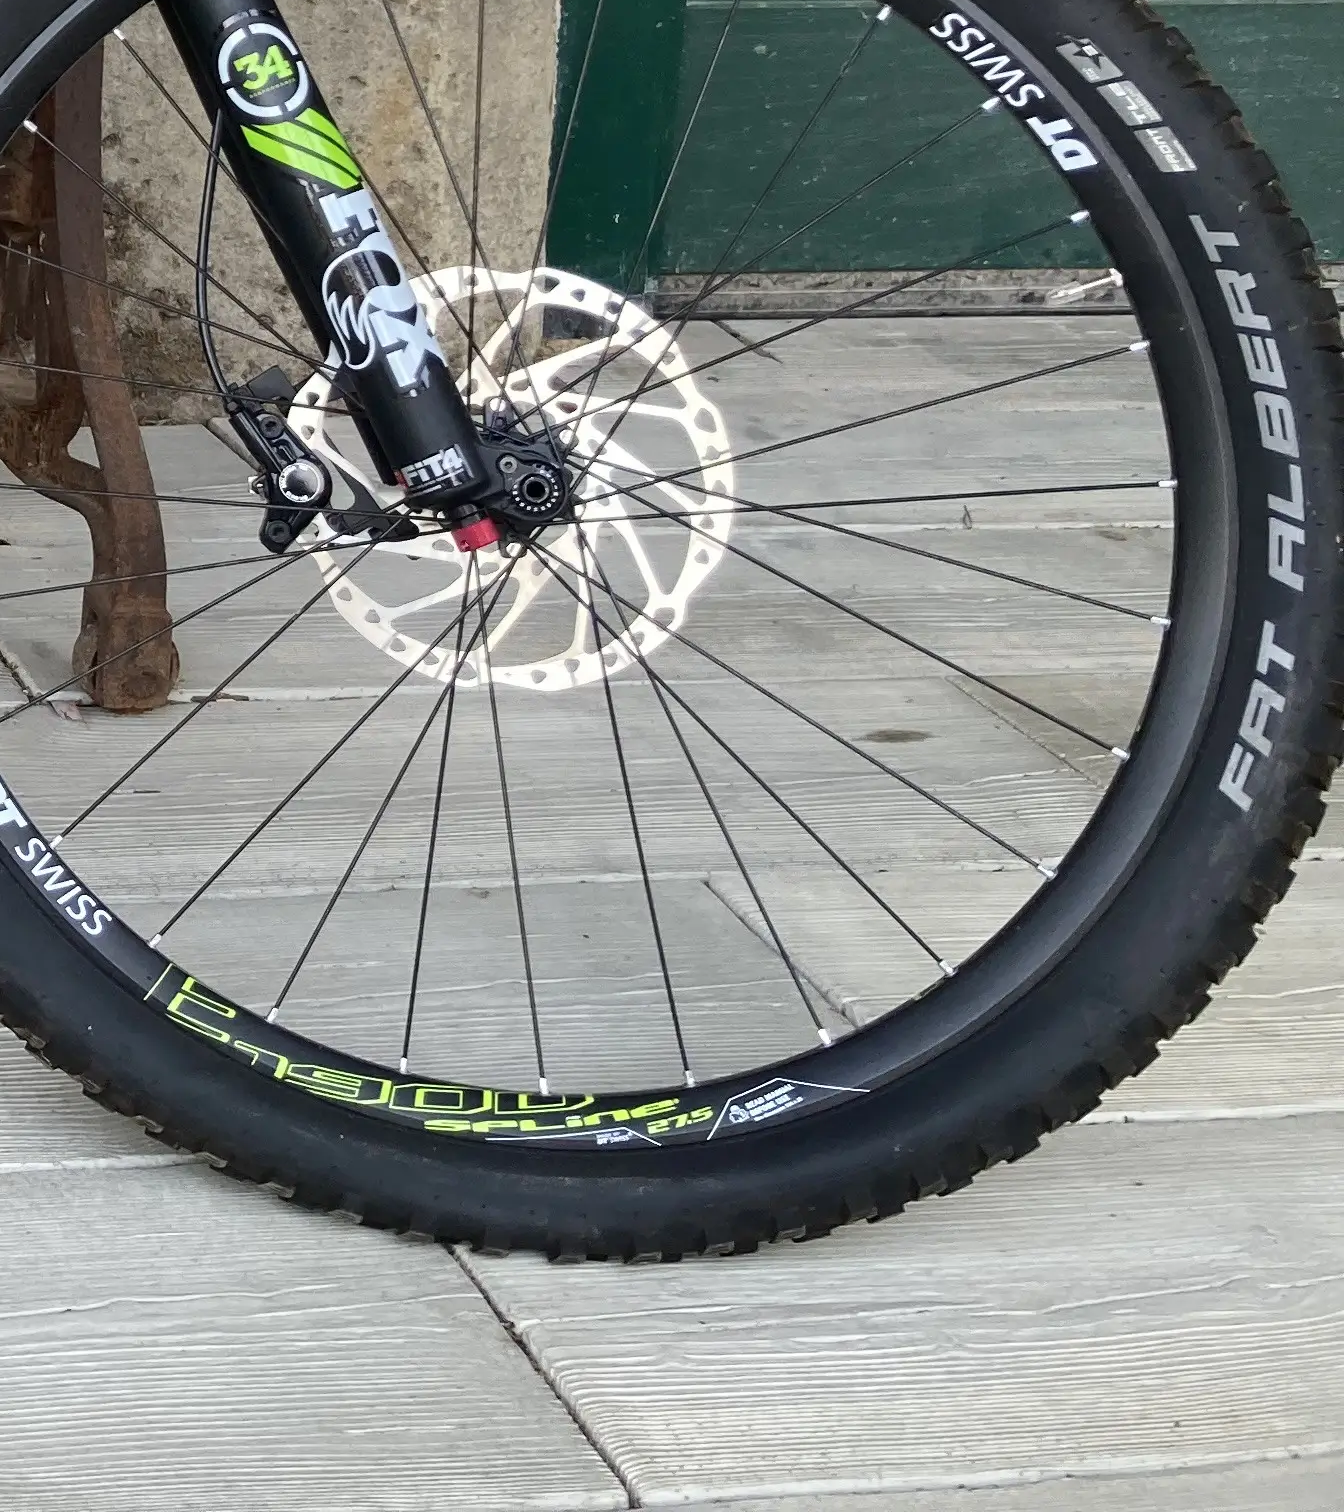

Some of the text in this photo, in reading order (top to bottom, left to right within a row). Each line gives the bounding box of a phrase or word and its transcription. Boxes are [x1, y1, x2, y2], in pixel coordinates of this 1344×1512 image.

[233, 44, 294, 90] 34
[929, 12, 1099, 172] DT SWISS
[318, 187, 450, 389] FOX
[1188, 213, 1307, 814] FAT ALBERT
[14, 836, 113, 939] SWISS
[647, 1105, 714, 1135] 27.5
